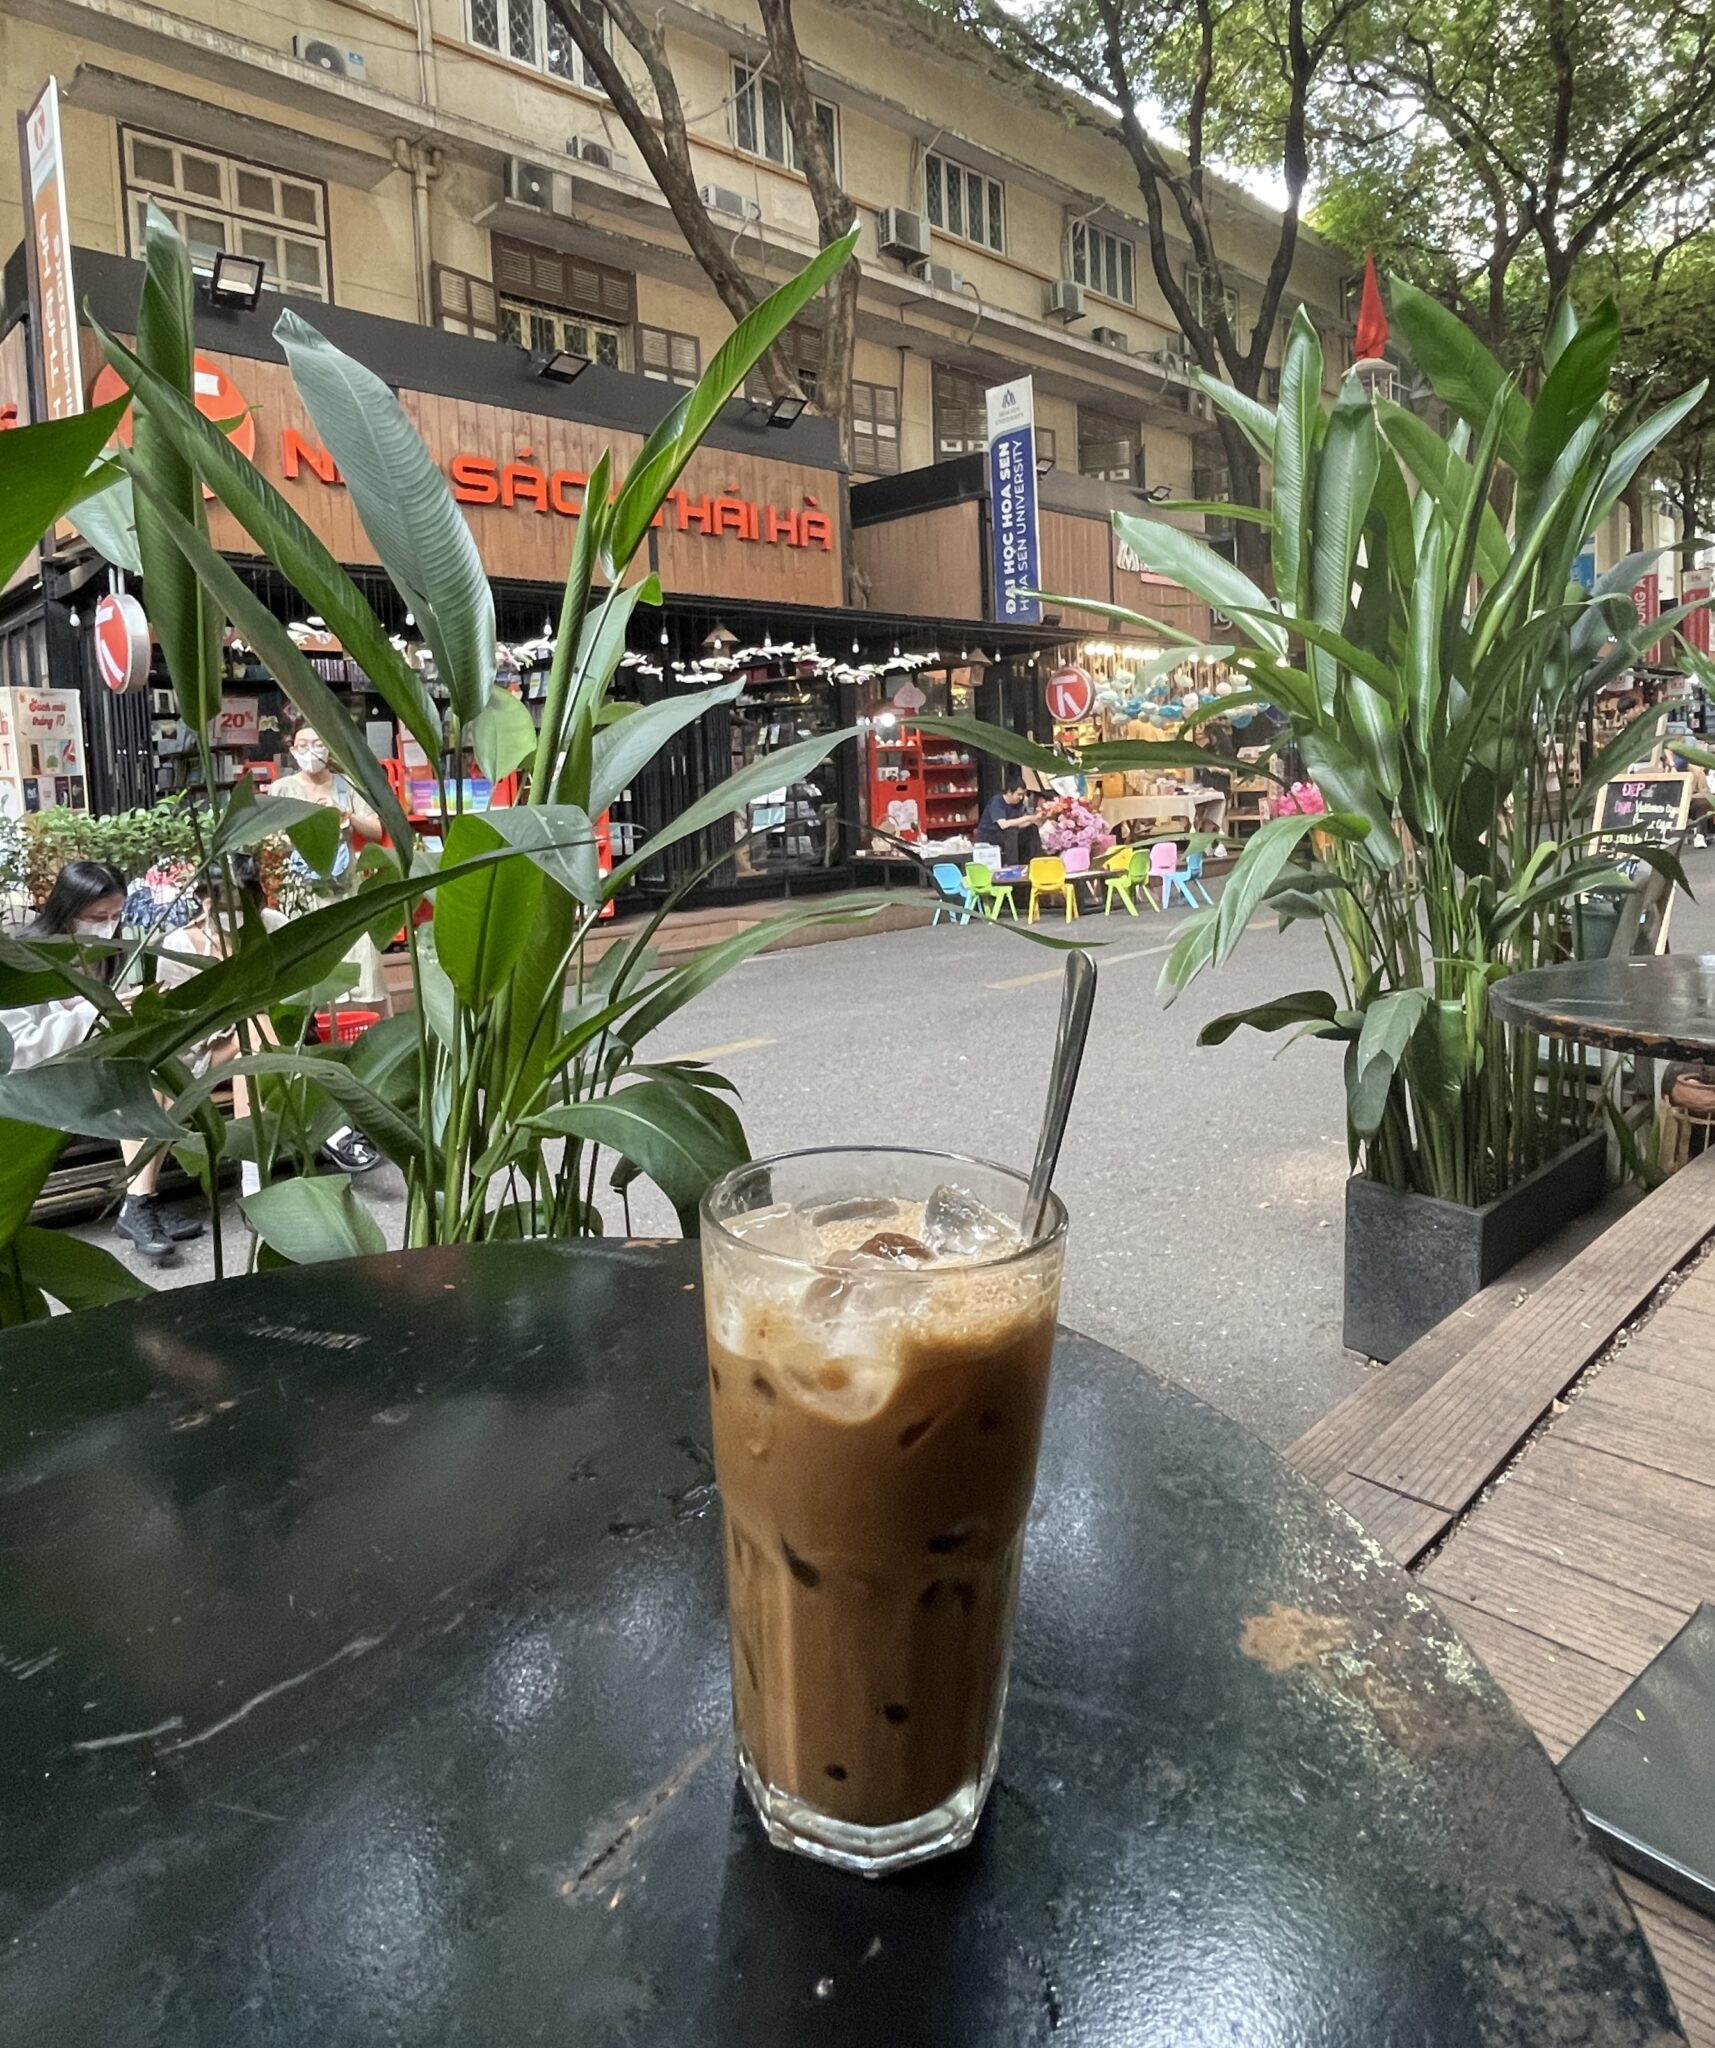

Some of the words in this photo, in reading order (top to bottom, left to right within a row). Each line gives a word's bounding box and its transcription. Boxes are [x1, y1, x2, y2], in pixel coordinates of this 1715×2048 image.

[998, 441, 1011, 481] SEN
[453, 448, 622, 518] SÁC
[765, 495, 833, 551] HÀ
[1000, 483, 1013, 529] HOA
[1012, 440, 1027, 535] UNIVERSITY
[1003, 532, 1017, 575] HỌC
[1016, 538, 1028, 571] SEN
